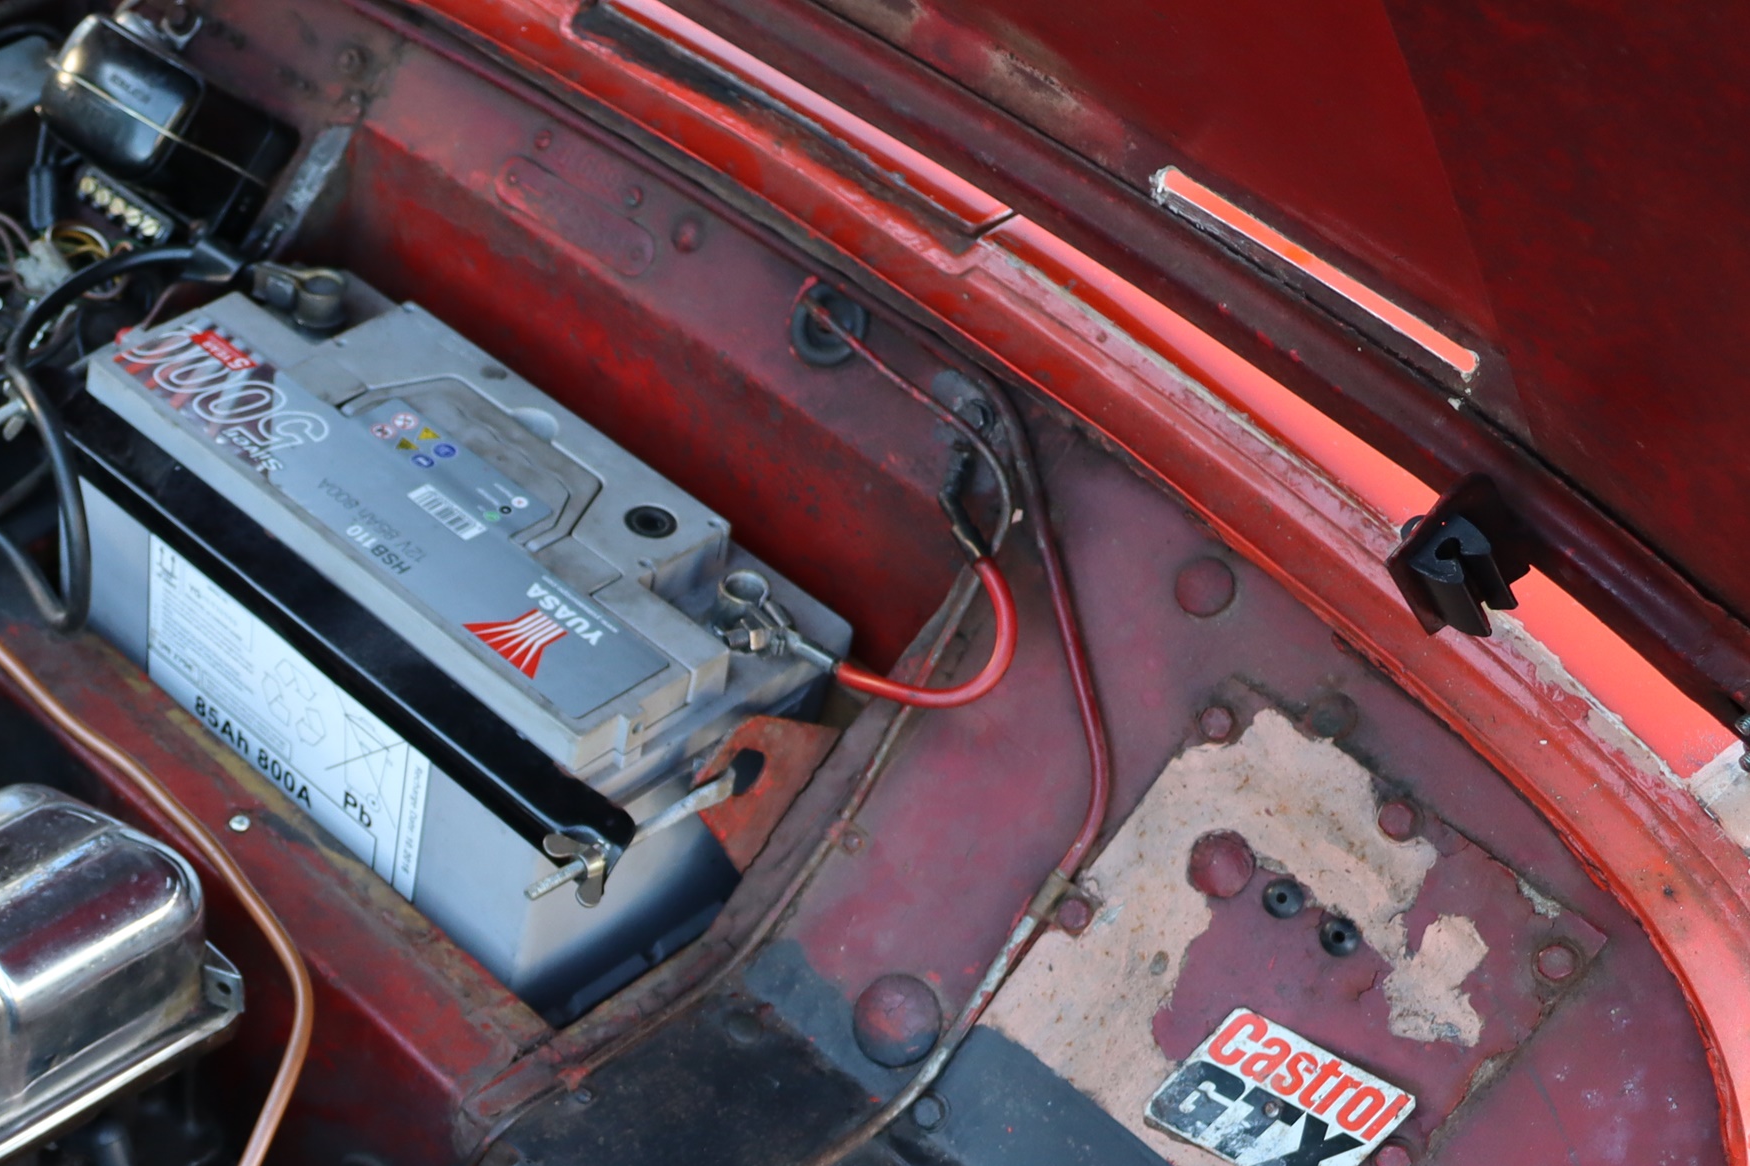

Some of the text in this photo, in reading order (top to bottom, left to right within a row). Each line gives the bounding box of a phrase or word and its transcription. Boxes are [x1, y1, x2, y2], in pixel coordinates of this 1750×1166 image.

[221, 427, 284, 472] Silver
[526, 582, 603, 646] YUASA
[195, 696, 249, 754] 85Ah
[257, 748, 312, 809] 800A
[343, 791, 372, 828] Pb
[1207, 1013, 1412, 1141] Castrol
